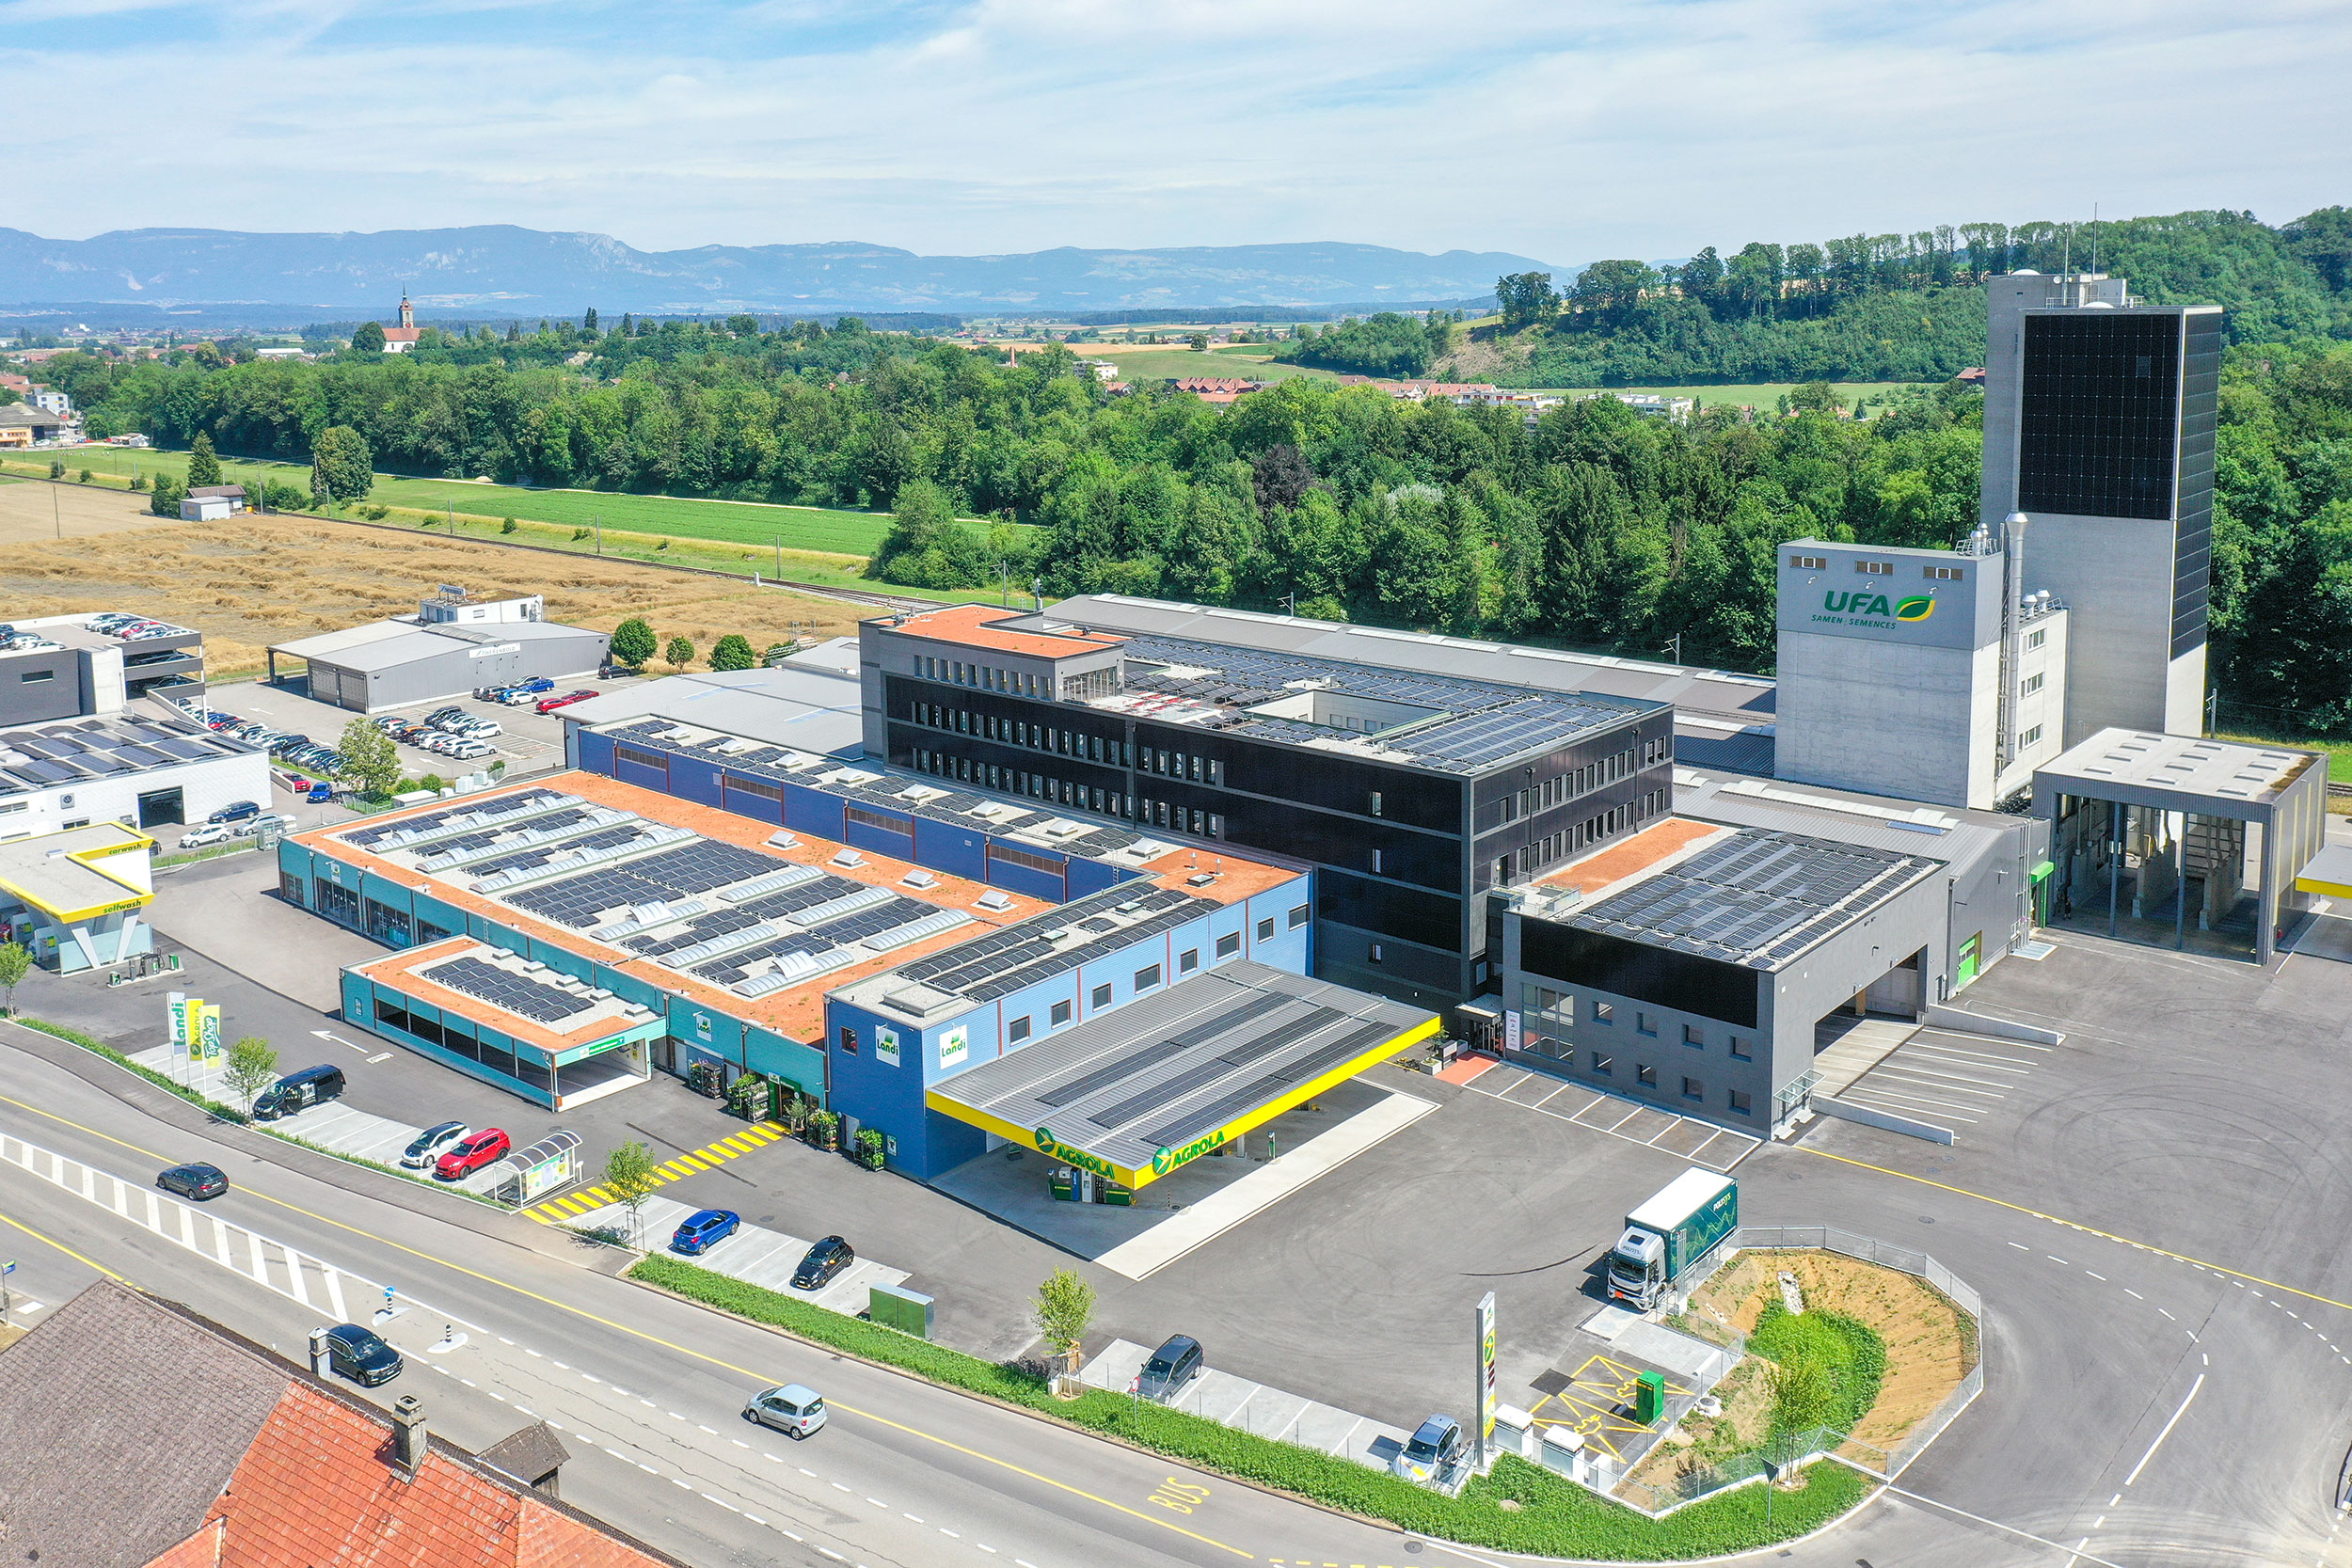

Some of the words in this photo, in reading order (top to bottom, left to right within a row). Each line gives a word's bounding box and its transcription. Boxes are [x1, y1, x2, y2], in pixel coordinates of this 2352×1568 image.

[1824, 591, 1890, 617] UFA
[1811, 614, 1843, 624] SAMEN
[1849, 618, 1897, 630] SEMENCES
[109, 843, 142, 855] carwash
[103, 899, 142, 913] selfwash
[171, 1003, 186, 1046] Landi
[877, 1038, 898, 1056] Landi
[942, 1038, 966, 1057] Landi
[1172, 1130, 1225, 1168] AGROLA
[1056, 1145, 1115, 1180] AGROLA
[1147, 1477, 1211, 1515] BUS
